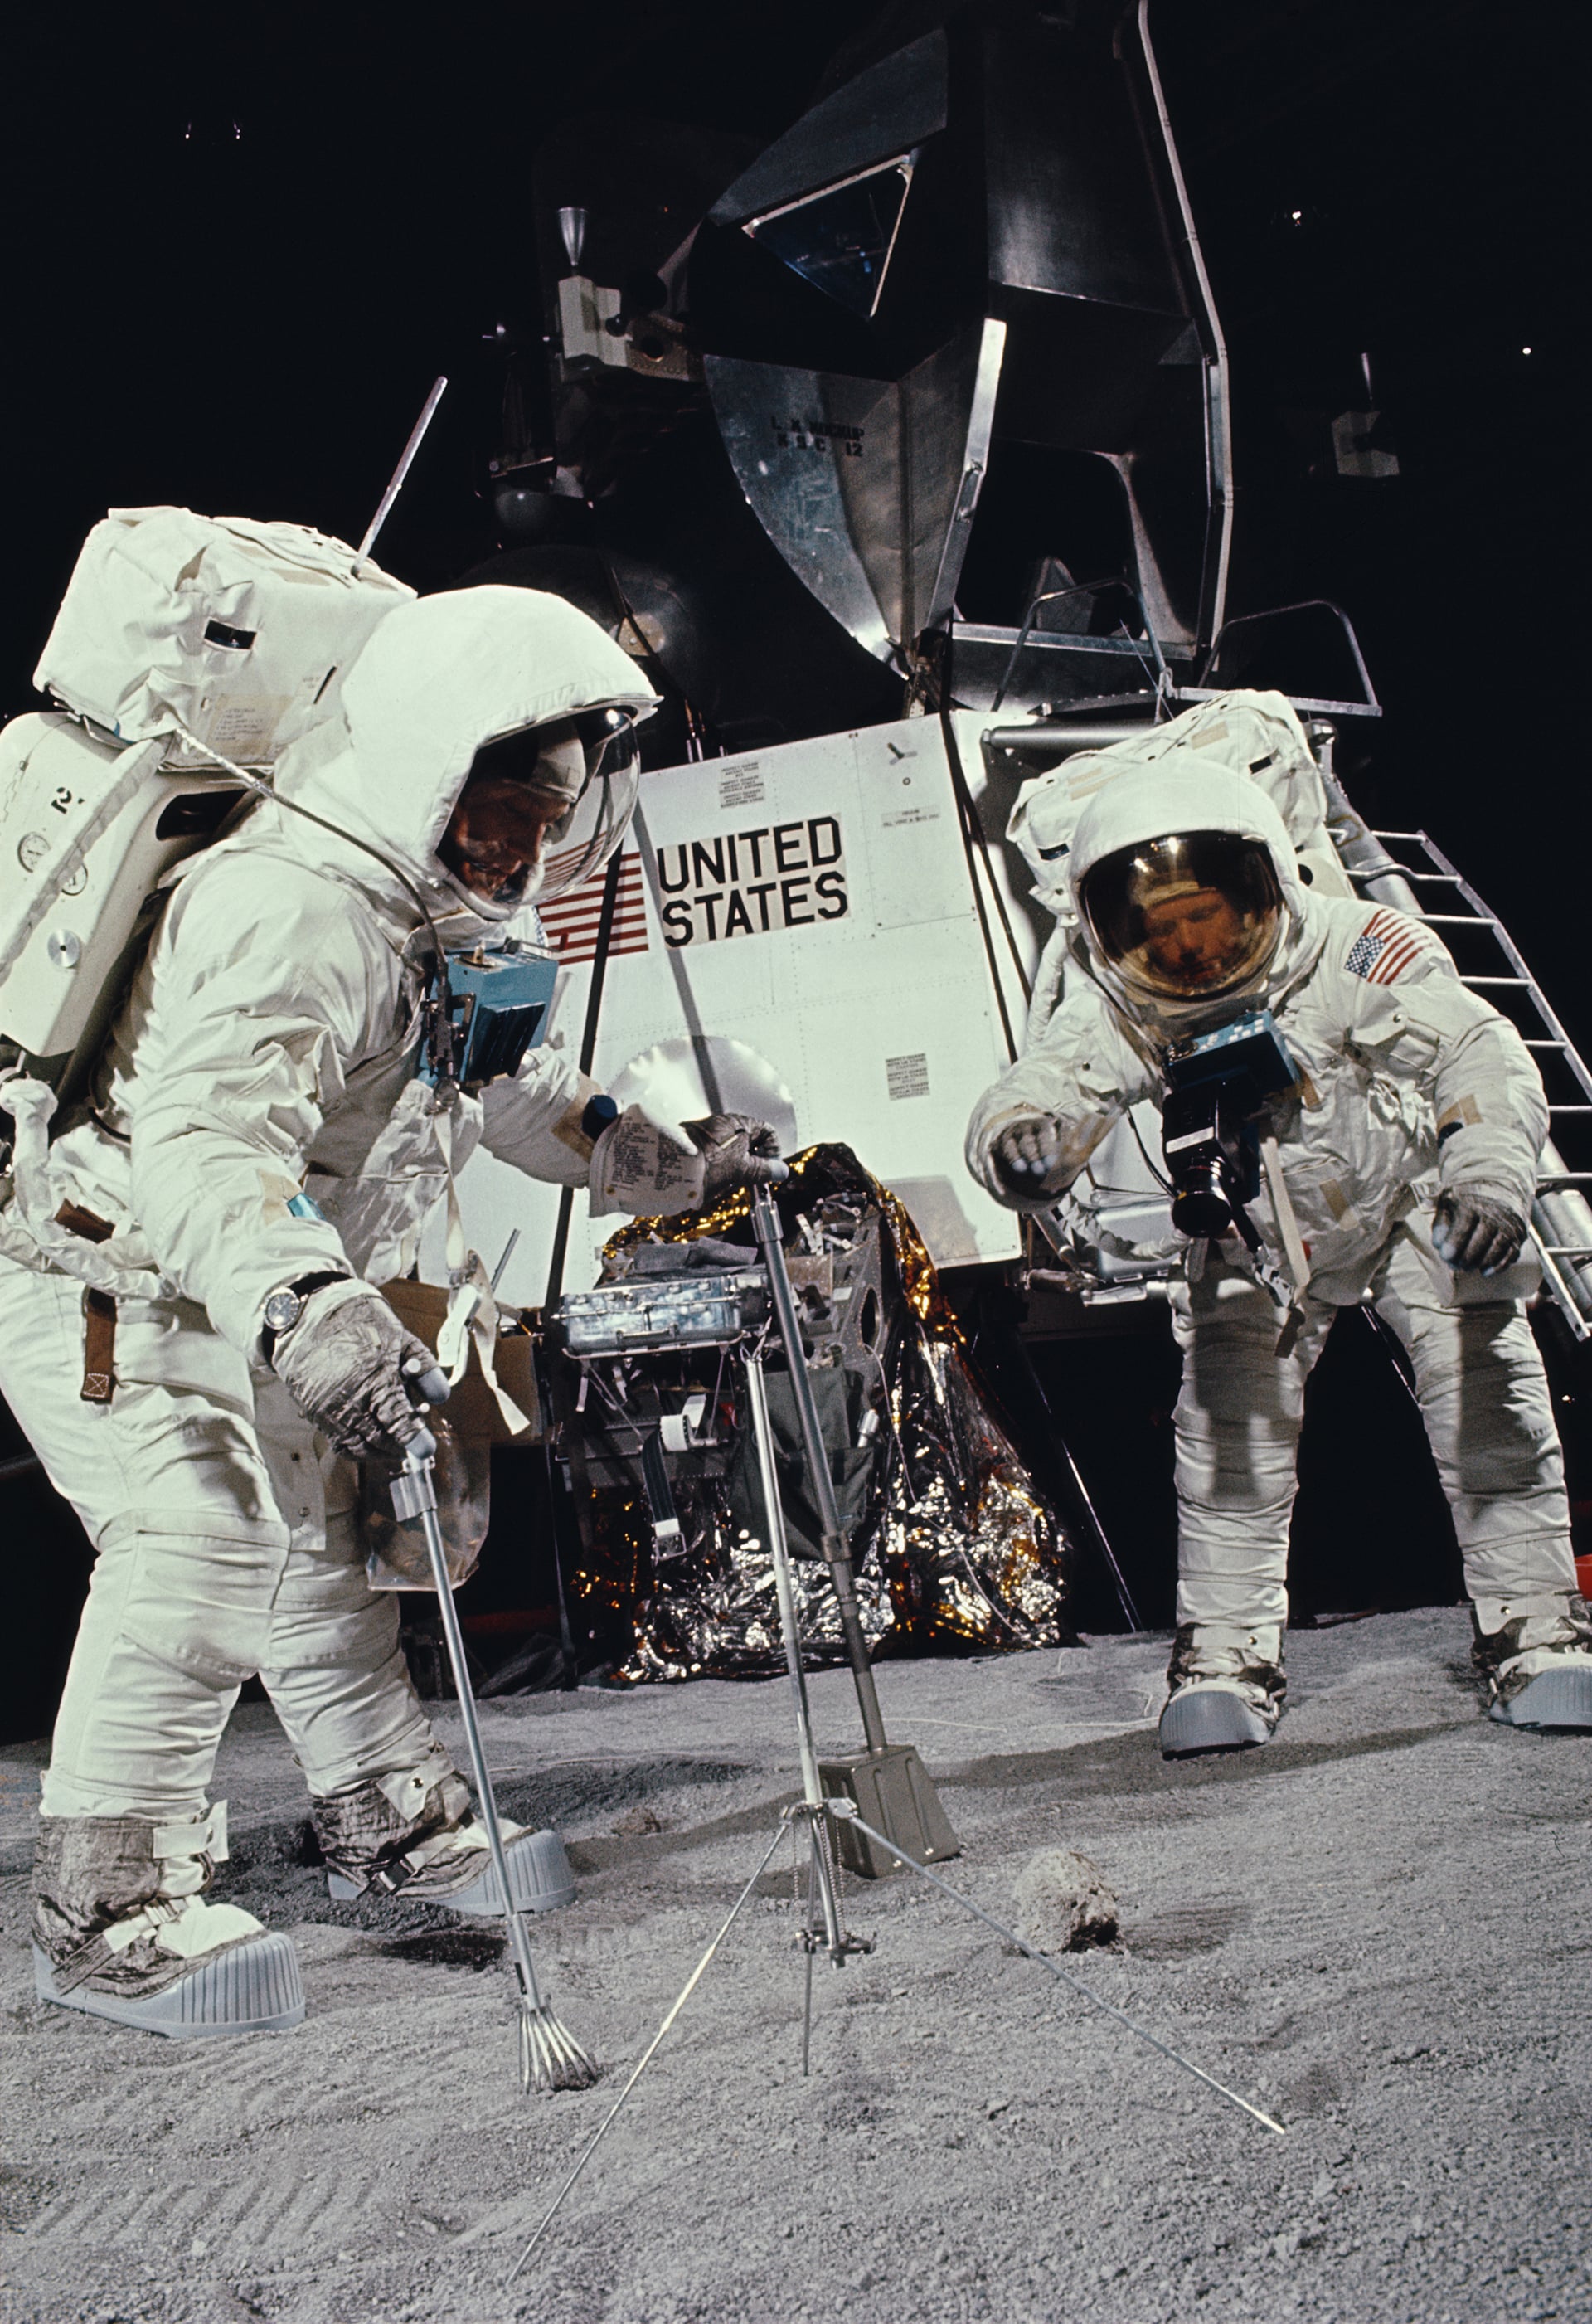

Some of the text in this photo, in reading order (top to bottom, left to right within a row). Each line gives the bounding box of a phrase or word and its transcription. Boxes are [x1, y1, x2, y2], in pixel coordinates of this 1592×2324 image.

[846, 441, 863, 457] 12
[656, 815, 842, 894] UNITED
[663, 870, 849, 948] STATES
